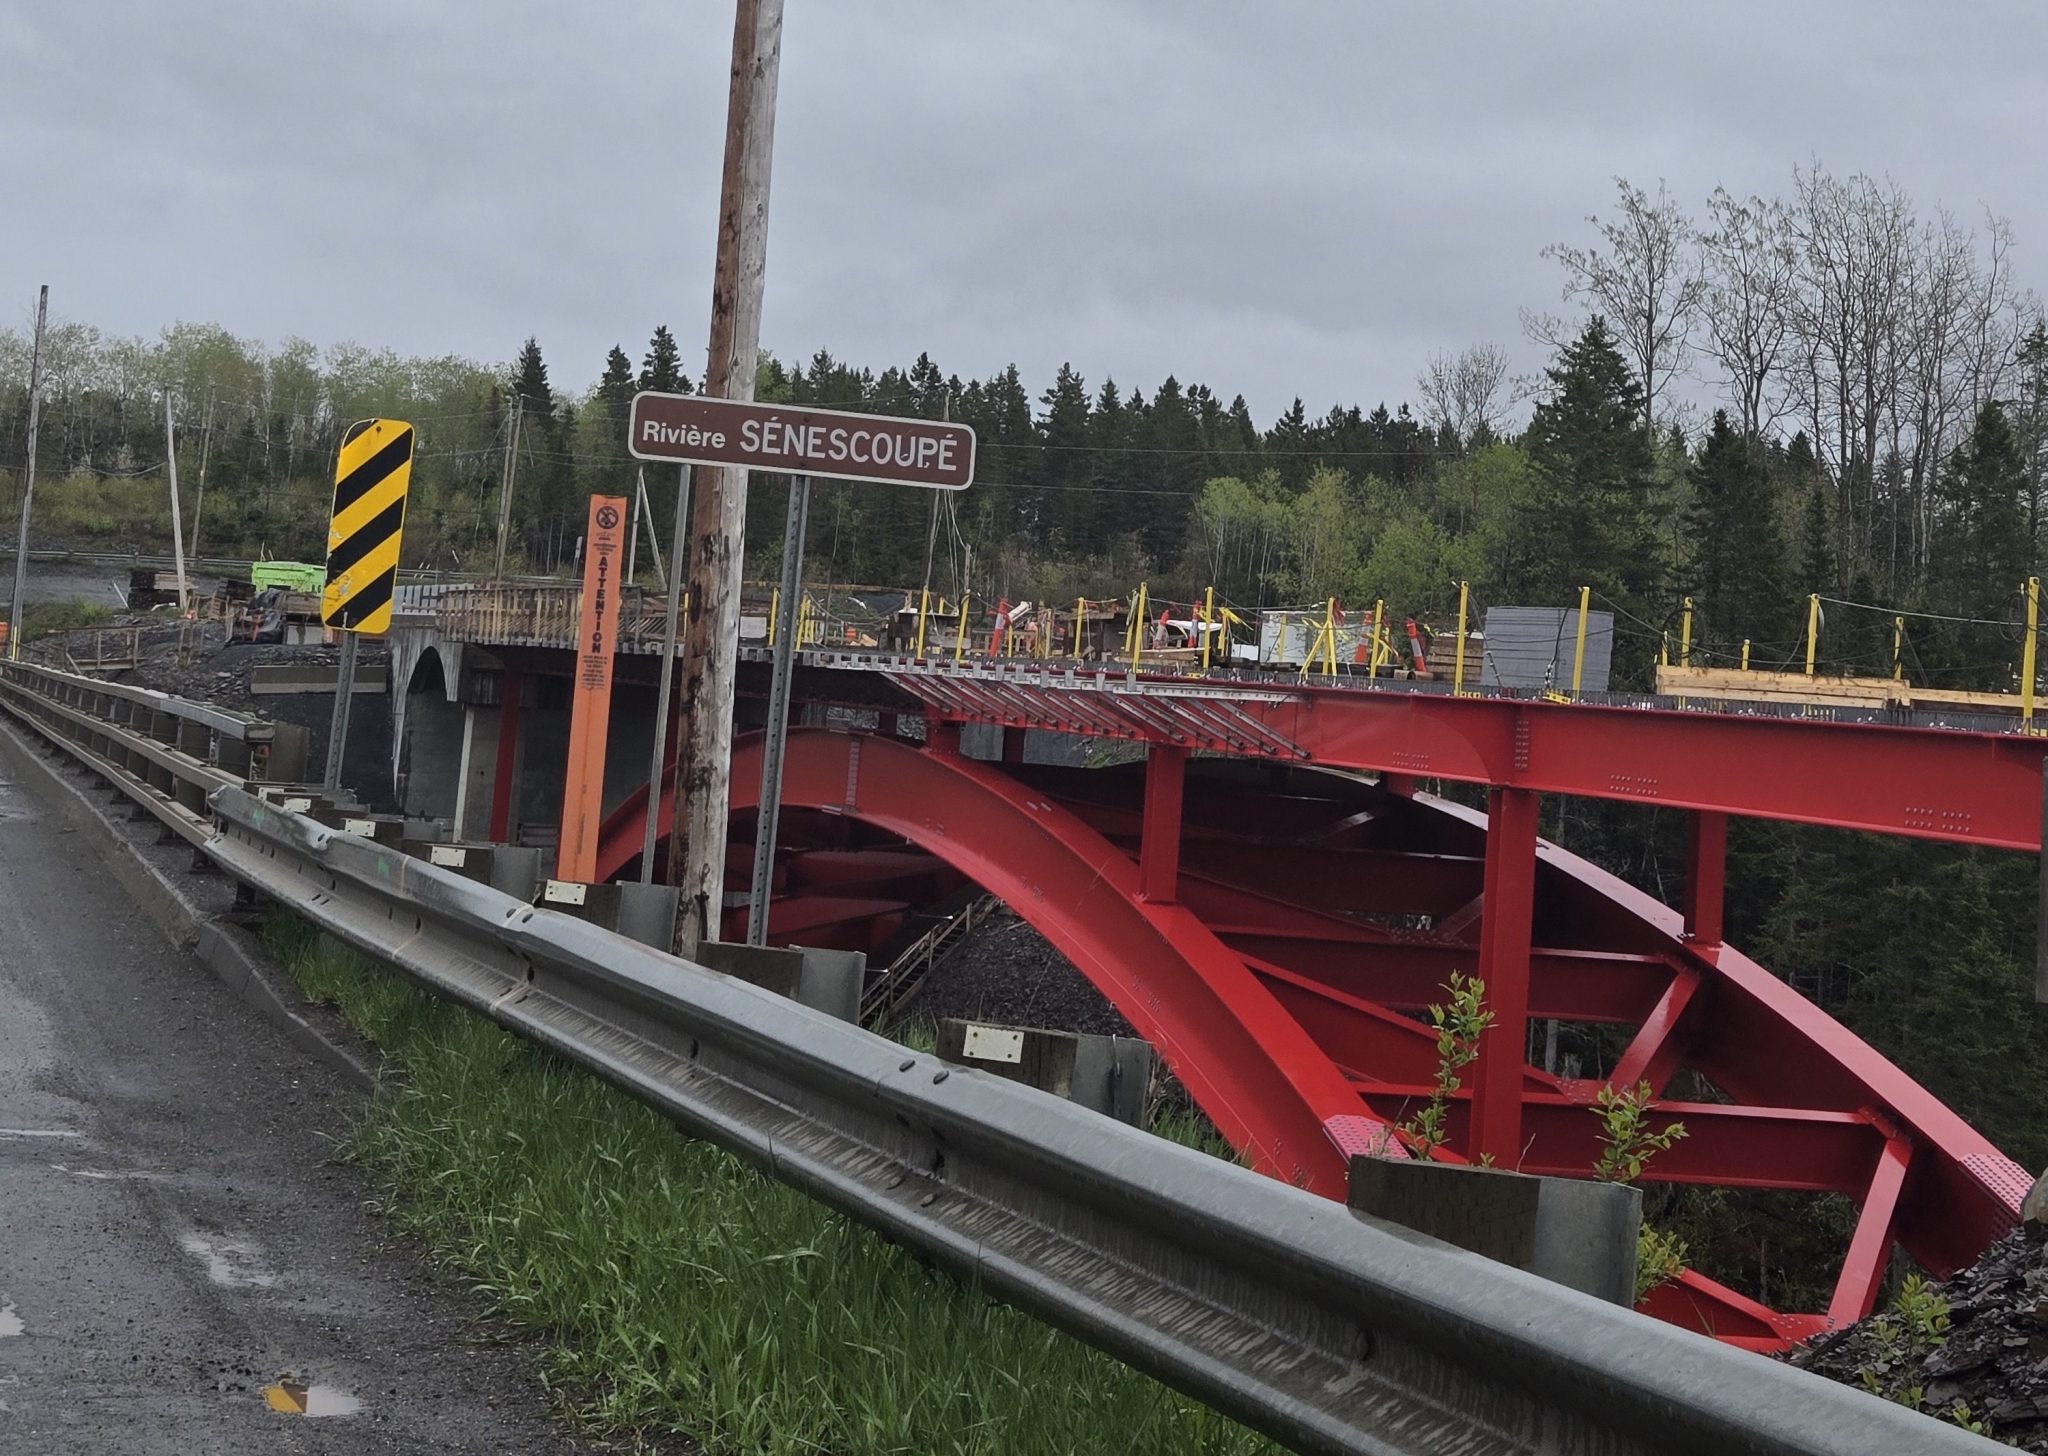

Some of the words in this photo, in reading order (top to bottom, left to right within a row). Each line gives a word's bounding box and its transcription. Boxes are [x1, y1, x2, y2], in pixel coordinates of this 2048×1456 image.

[642, 420, 726, 449] Rivière
[740, 416, 957, 471] SÉNESCOUPÉ
[592, 556, 608, 653] ATTENTION
